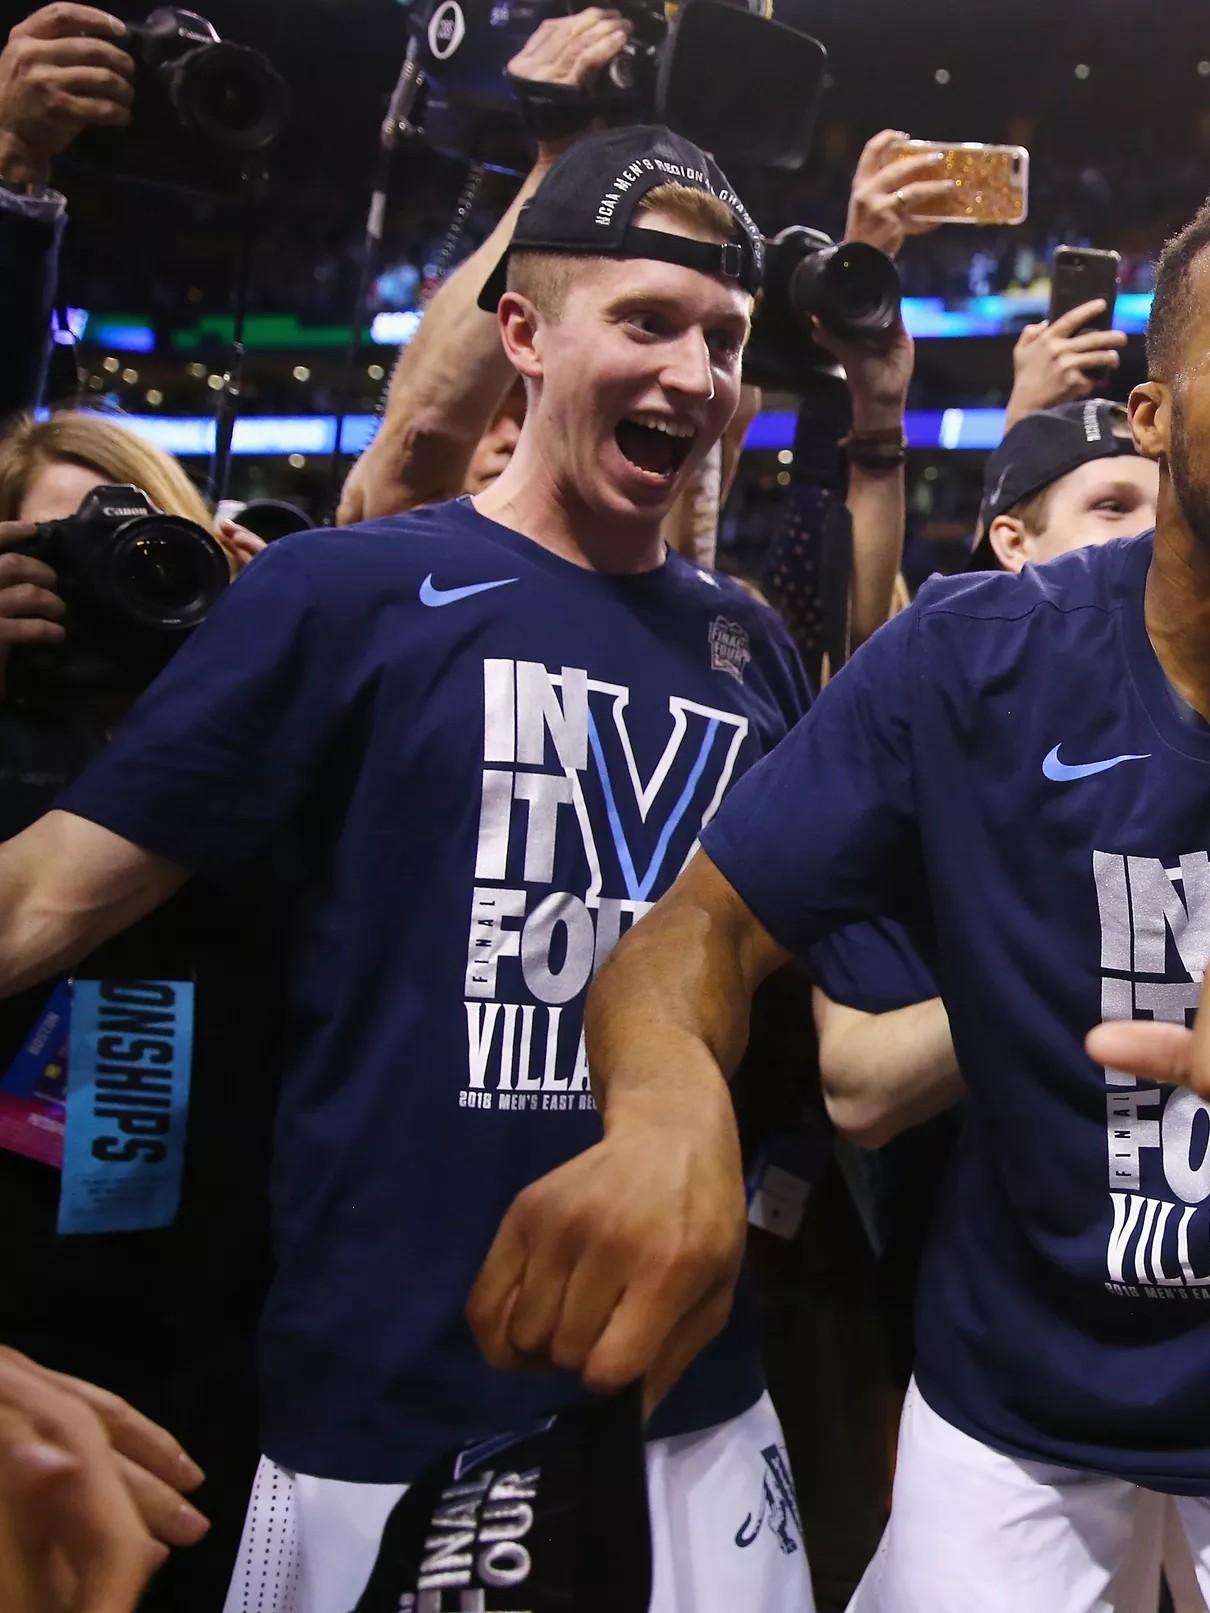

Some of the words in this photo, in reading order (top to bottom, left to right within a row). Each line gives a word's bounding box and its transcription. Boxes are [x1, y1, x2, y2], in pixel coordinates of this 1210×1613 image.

[595, 193, 620, 226] NCAA
[614, 158, 654, 191] MEN'S
[655, 159, 716, 196] REGIONAL
[103, 506, 148, 516] Canon
[713, 627, 746, 647] FINAL
[483, 658, 588, 771] IN
[474, 769, 574, 883] IT
[472, 899, 496, 983] FINAL
[459, 1090, 492, 1109] 2018
[498, 1092, 538, 1111] MEN'S
[542, 1094, 575, 1111] EAST
[1113, 1096, 1132, 1177] FINAL
[1143, 1286, 1190, 1300] MEN'S
[478, 1466, 542, 1590] OUR
